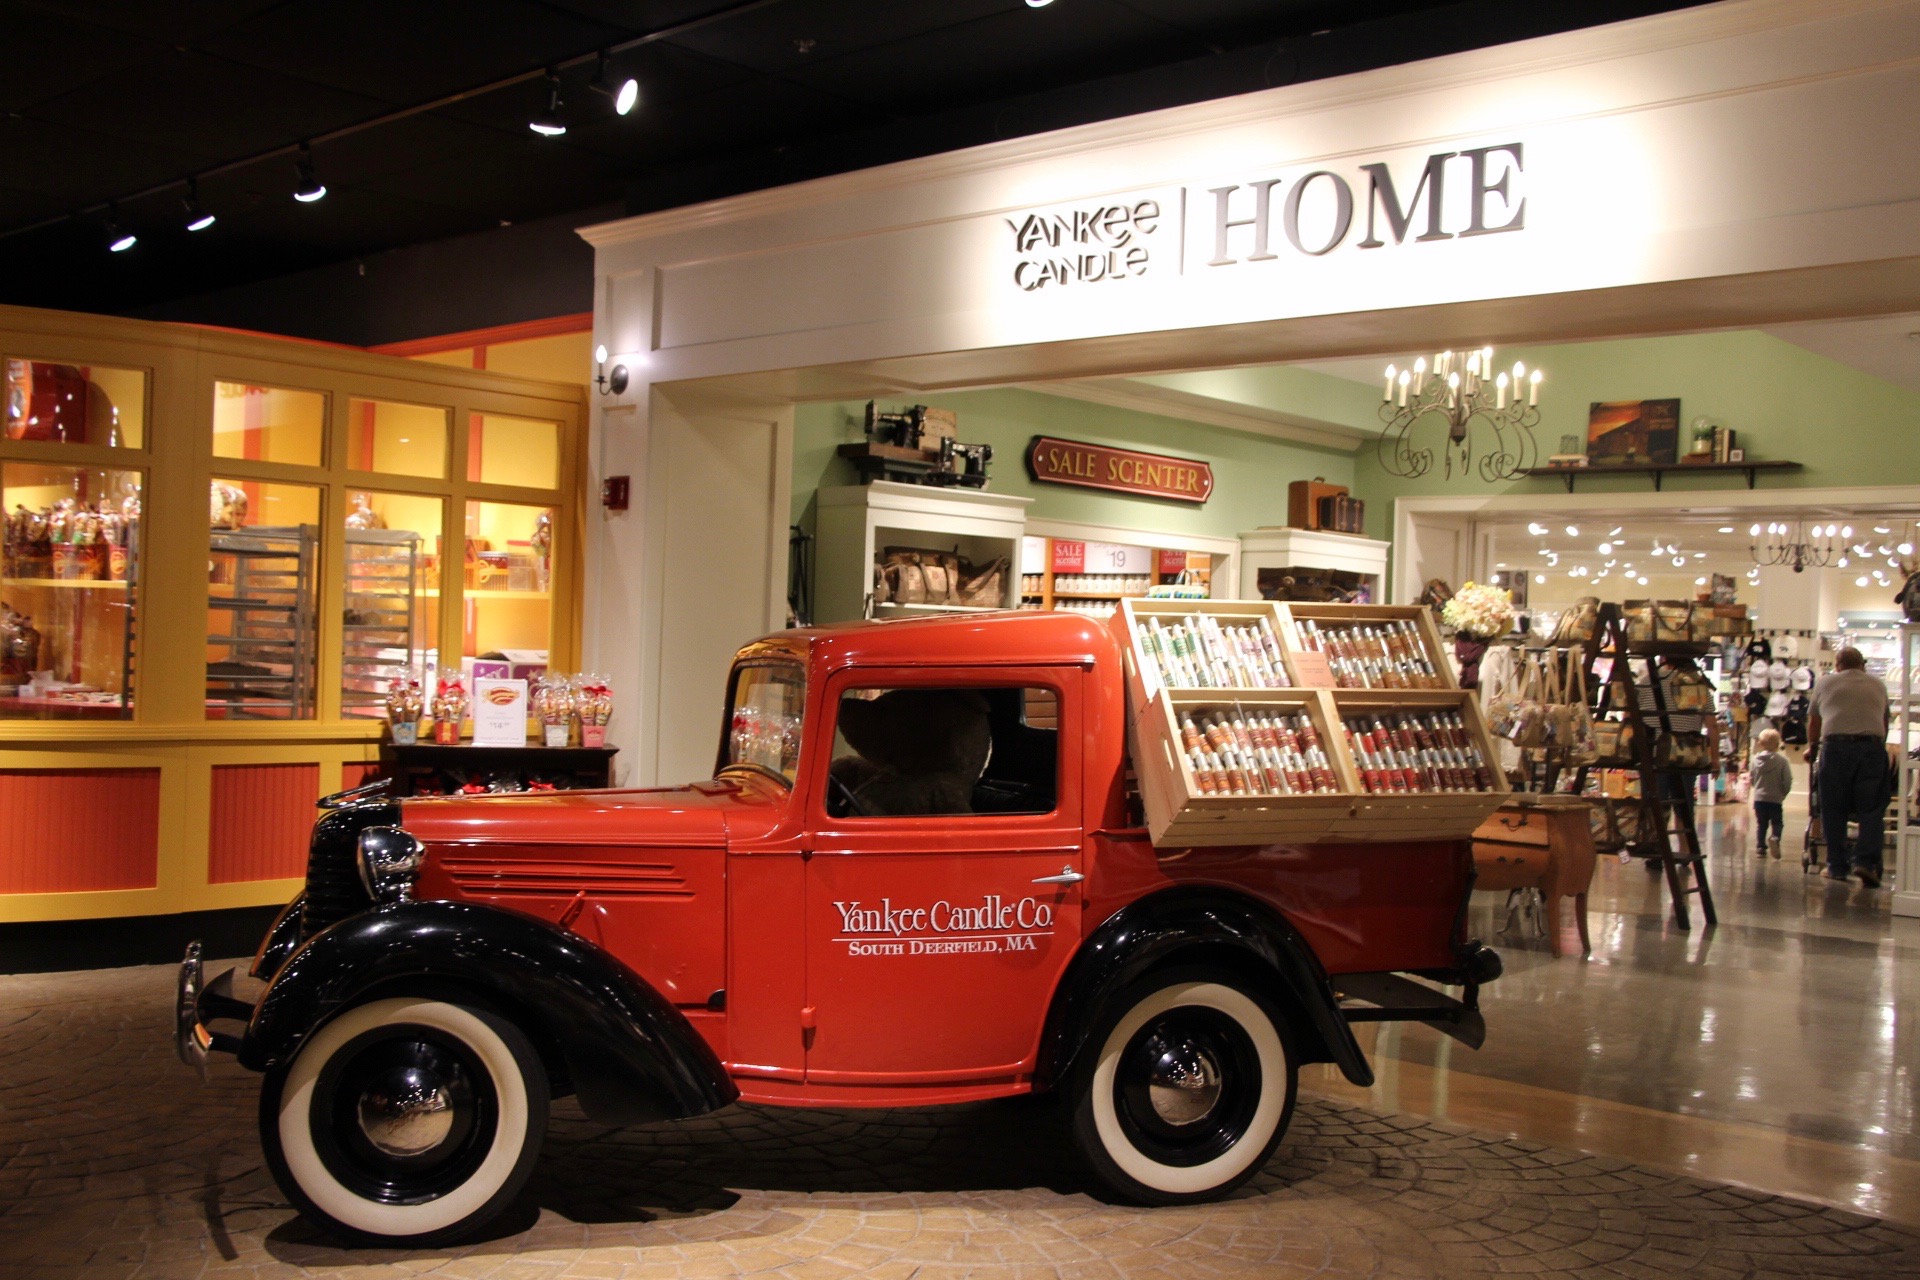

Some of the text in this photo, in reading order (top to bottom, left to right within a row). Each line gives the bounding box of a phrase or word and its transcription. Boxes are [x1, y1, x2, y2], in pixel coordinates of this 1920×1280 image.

[1206, 142, 1527, 266] HOME
[1048, 449, 1199, 492] SALE SCENTER
[1056, 544, 1083, 558] SALE
[1056, 556, 1083, 567] scenter
[833, 898, 927, 937] Yankee
[1017, 897, 1054, 928] Co.
[848, 940, 904, 956] SOUTH
[1005, 935, 1037, 951] MA
